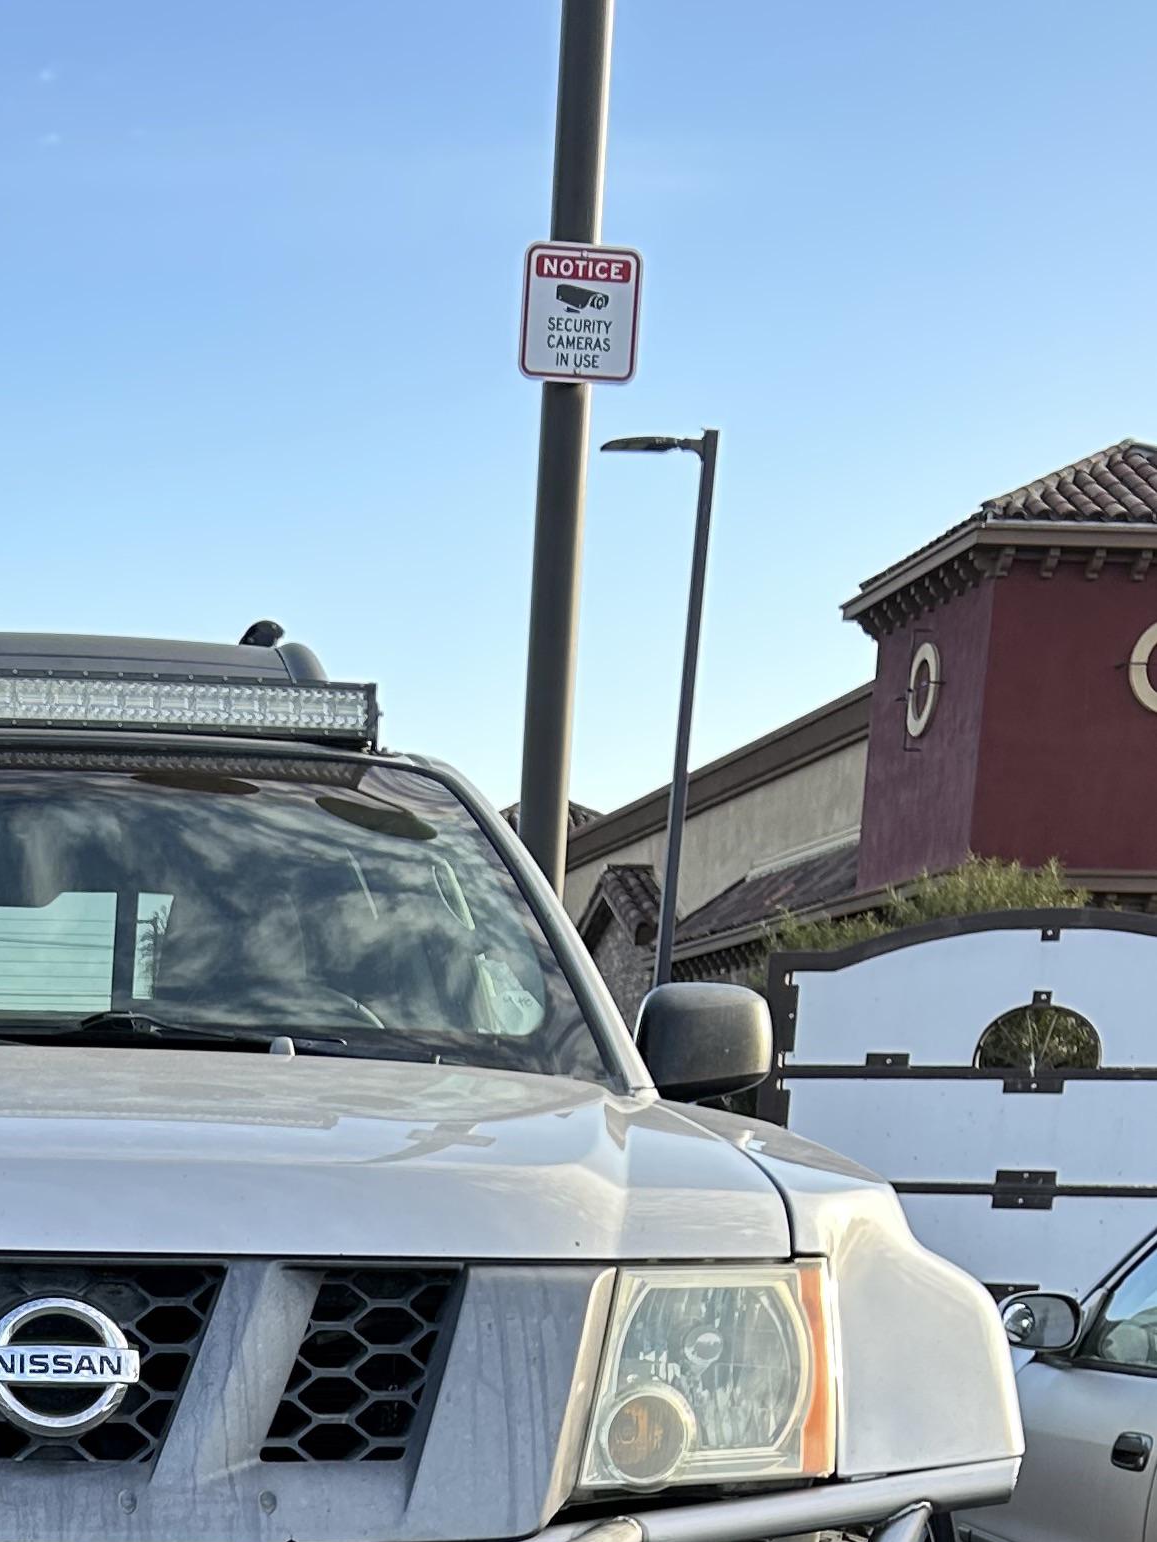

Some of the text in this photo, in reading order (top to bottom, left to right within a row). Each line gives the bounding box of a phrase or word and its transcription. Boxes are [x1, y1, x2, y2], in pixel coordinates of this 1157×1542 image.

[543, 258, 624, 280] NOTICE
[547, 316, 613, 334] SECURITY
[546, 334, 611, 352] CAMERAS
[555, 353, 600, 369] IN USE
